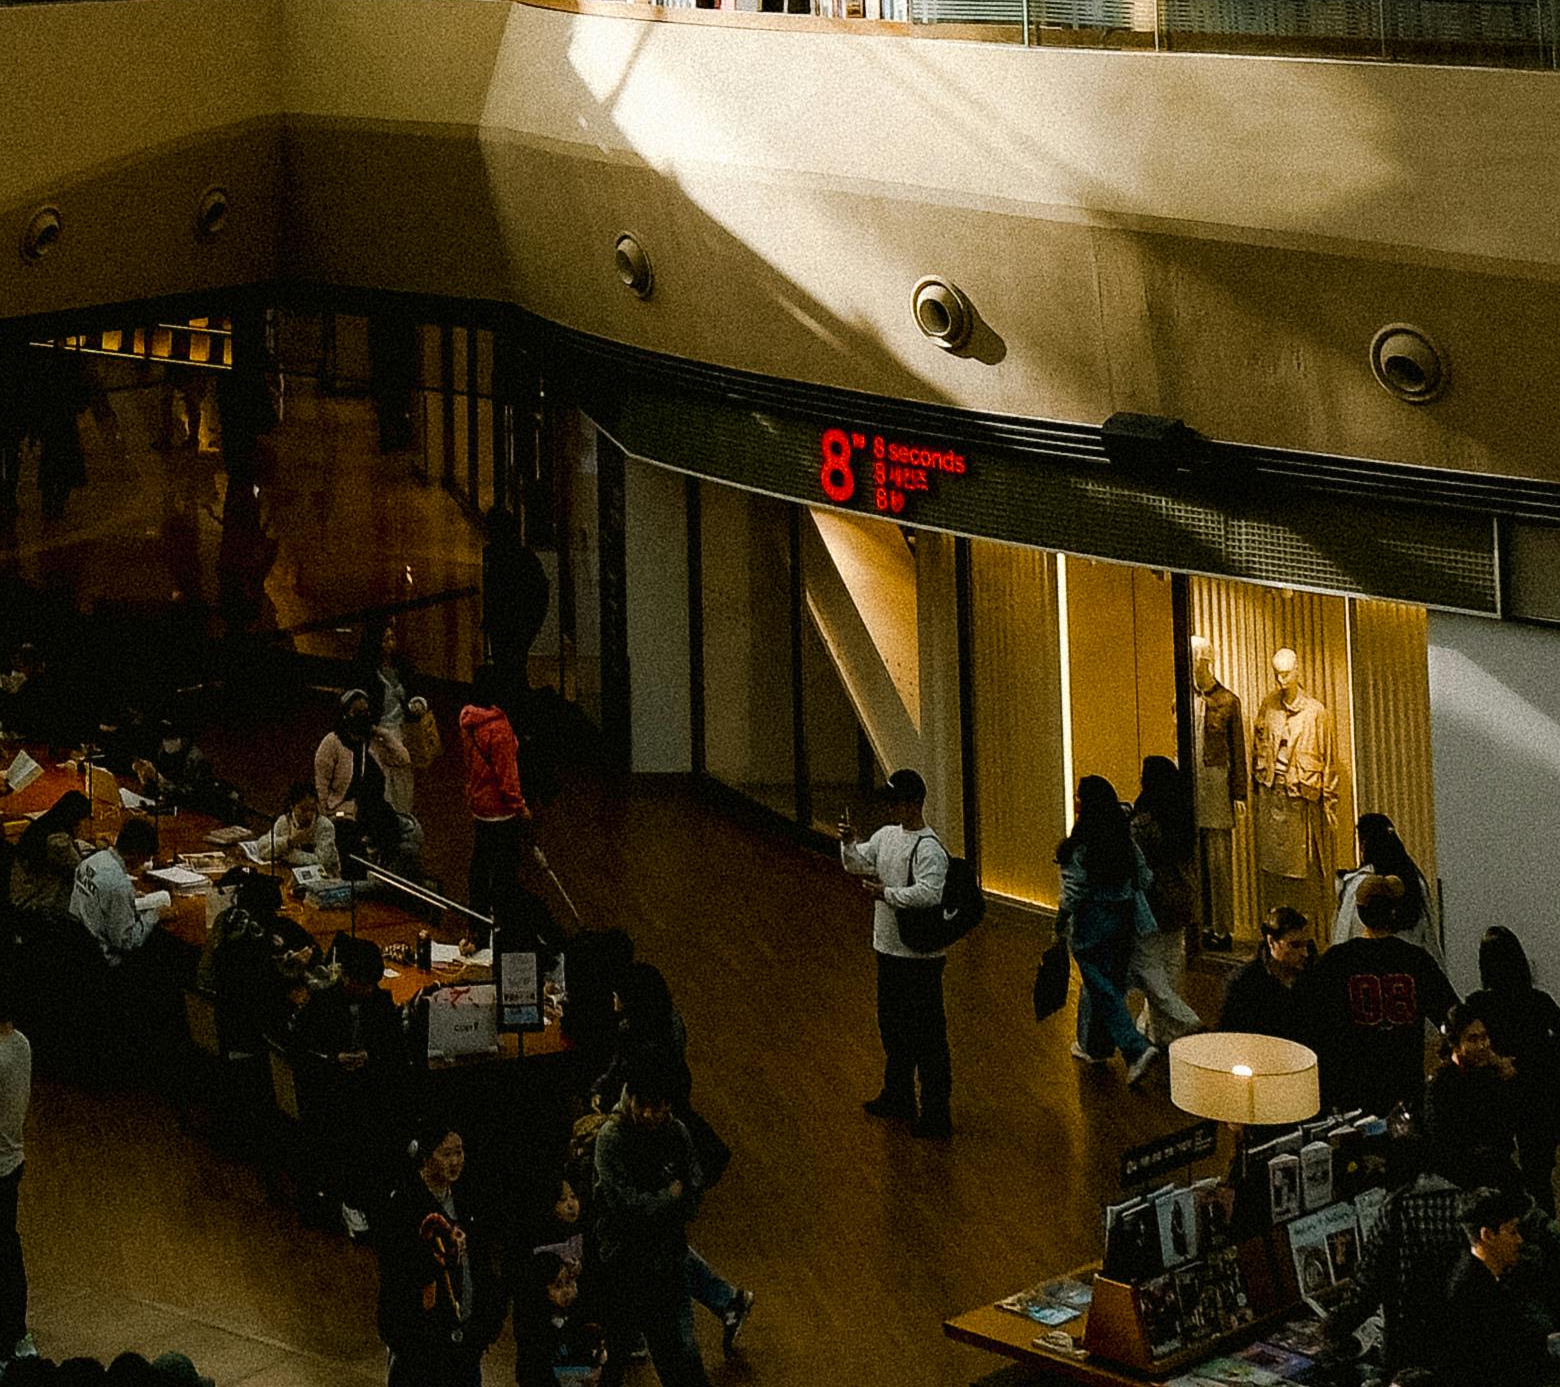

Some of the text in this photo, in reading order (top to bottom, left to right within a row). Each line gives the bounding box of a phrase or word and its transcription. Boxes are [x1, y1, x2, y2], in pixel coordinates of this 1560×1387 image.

[873, 435, 966, 474] 8 seconds
[1348, 973, 1416, 1026] 08
